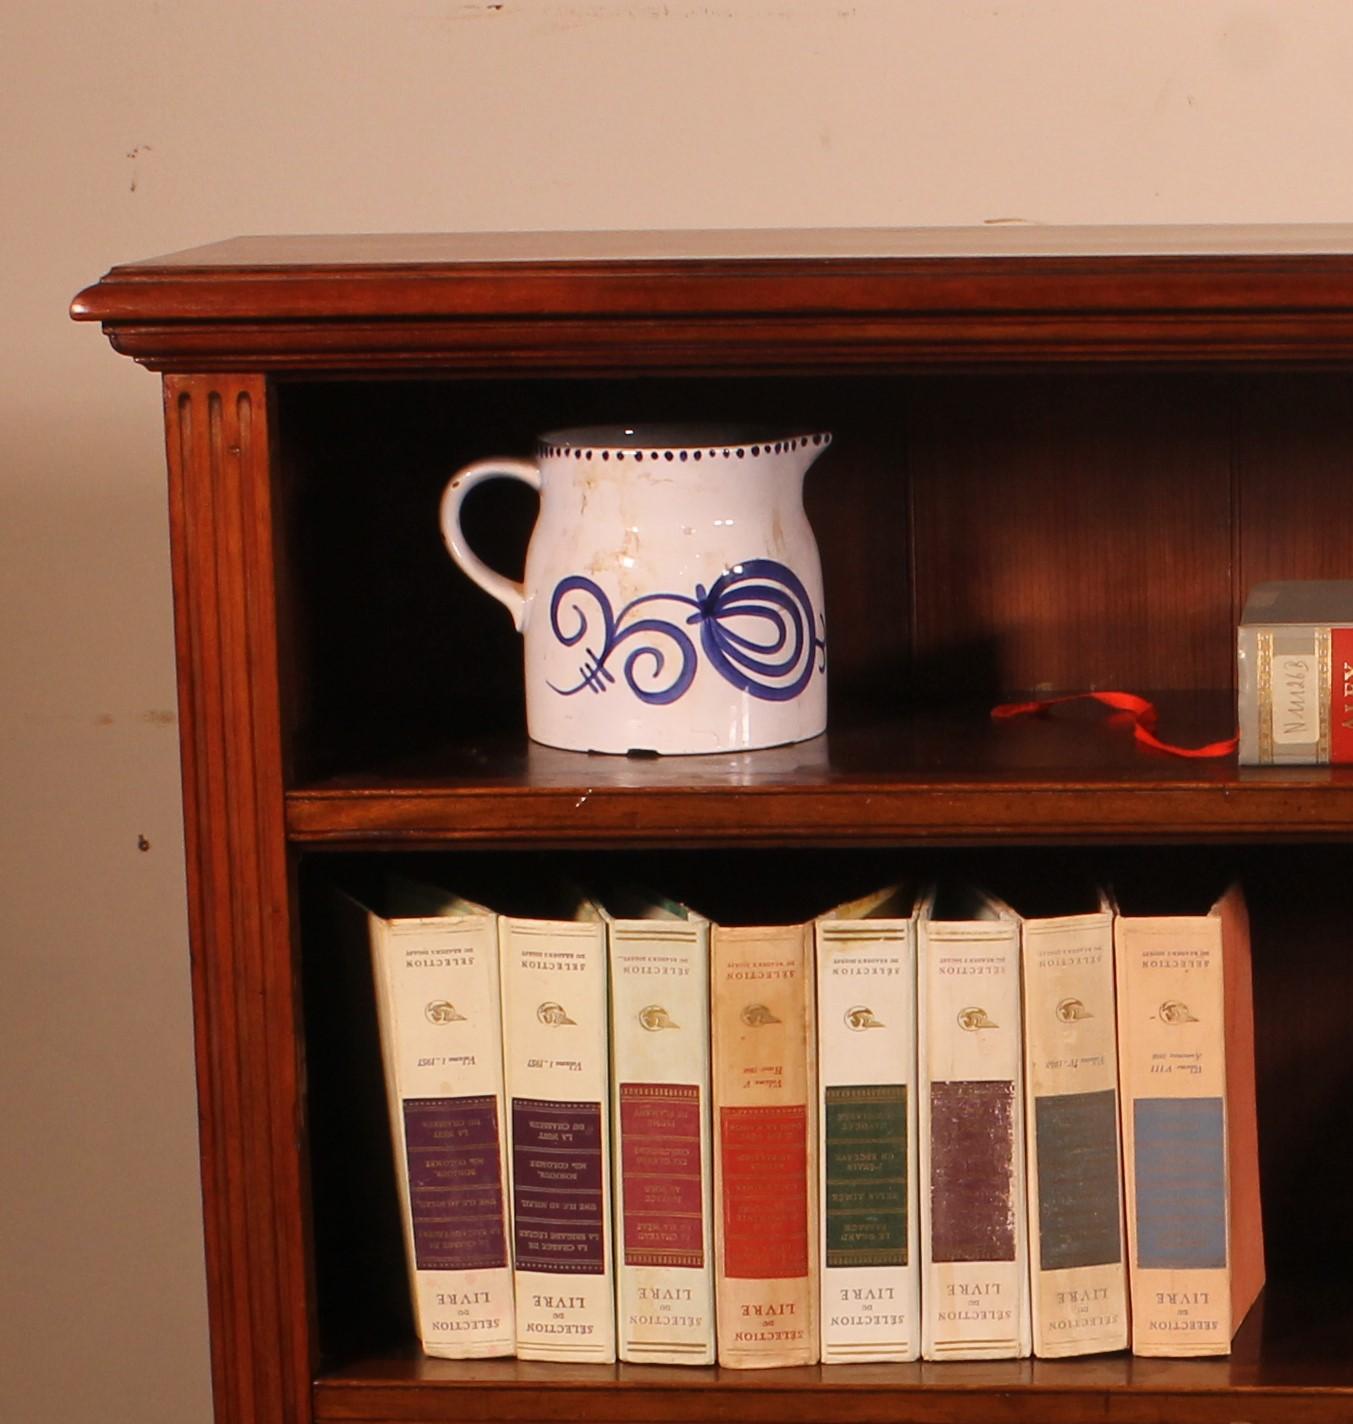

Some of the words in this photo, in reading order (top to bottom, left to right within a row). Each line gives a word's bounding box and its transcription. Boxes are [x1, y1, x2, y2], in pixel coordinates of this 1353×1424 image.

[637, 1287, 692, 1302] LIVRE
[840, 1287, 895, 1301] LIVRE
[947, 1284, 1001, 1298] LIVRE
[1056, 1288, 1108, 1304] LIVRE
[436, 1292, 491, 1307] LIVRE
[532, 1294, 585, 1310] LIVRE
[1155, 1292, 1209, 1306] LIVRE
[740, 1303, 796, 1318] LIVRE
[432, 1318, 501, 1333] SÉLECTION
[629, 1314, 703, 1329] SÉLECTION
[831, 1314, 905, 1328] SÉLECTION
[525, 1322, 594, 1337] SÉLECTION
